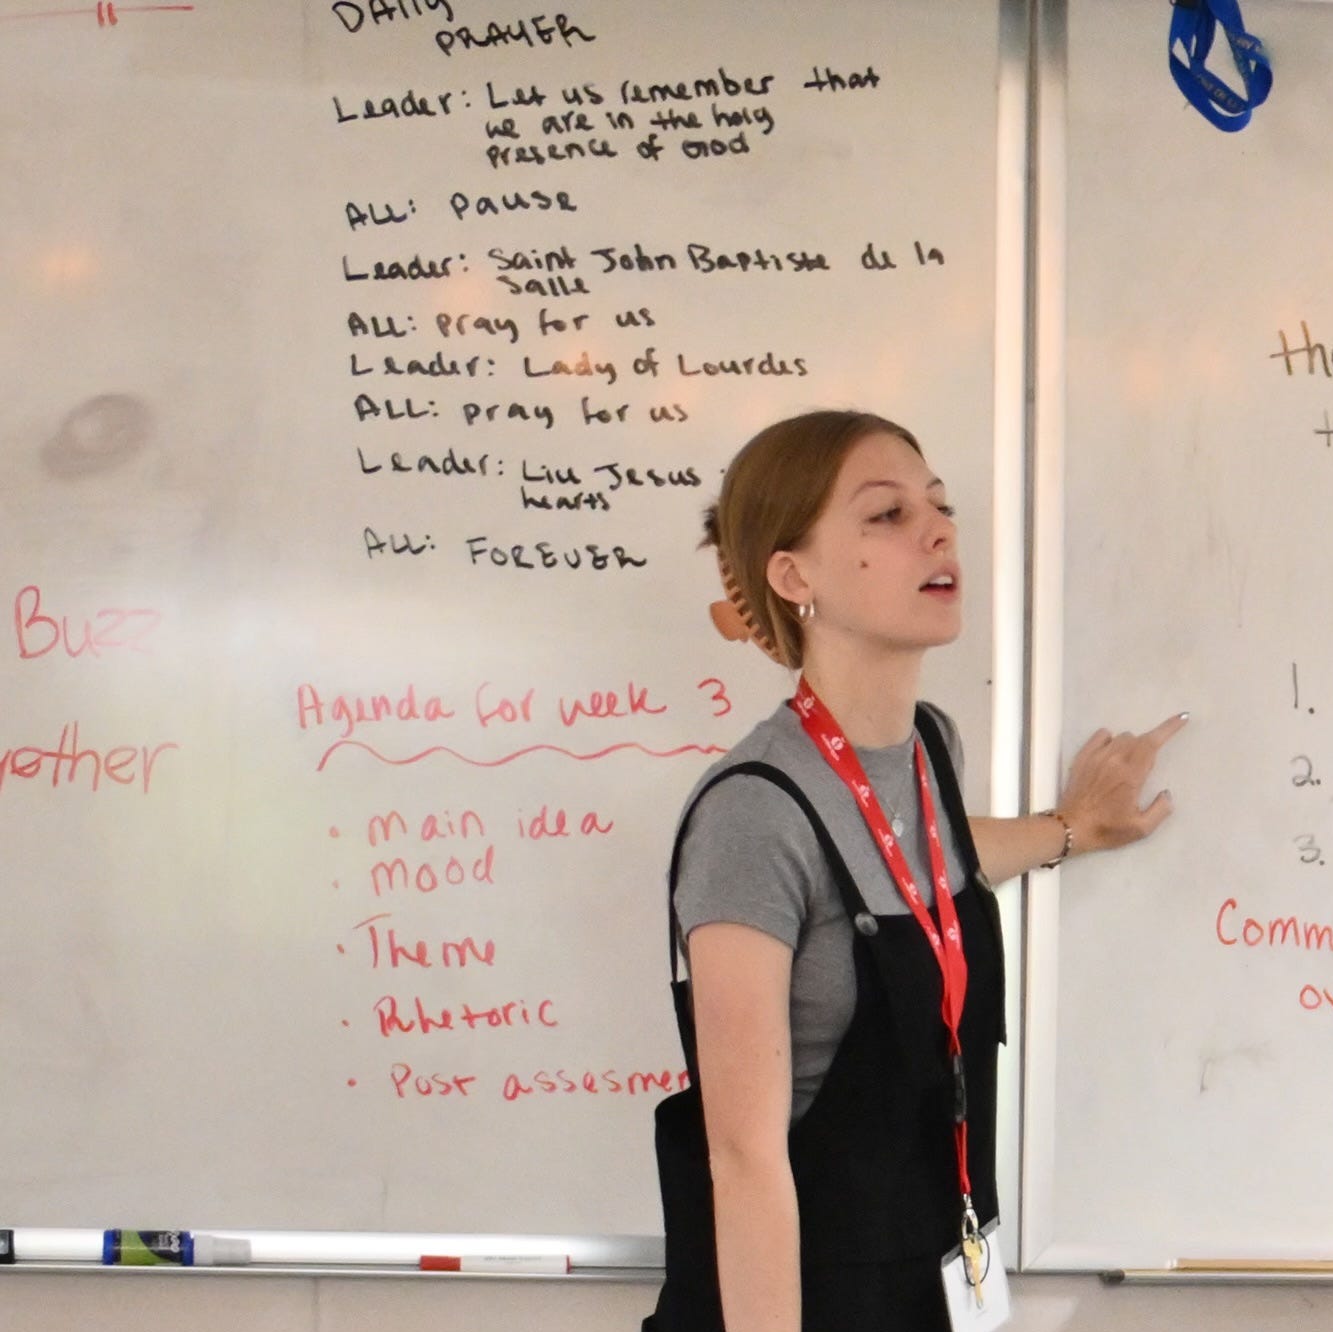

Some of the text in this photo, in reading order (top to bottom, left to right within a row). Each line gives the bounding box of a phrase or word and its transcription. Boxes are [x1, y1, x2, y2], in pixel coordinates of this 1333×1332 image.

[435, 13, 597, 57] PRAYER
[332, 66, 881, 124] Leader: Let us remember that
[541, 110, 595, 136] are
[605, 111, 635, 130] in
[649, 108, 703, 131] the
[636, 132, 665, 162] of
[342, 253, 466, 282] Leader:
[487, 245, 577, 273] Saint
[589, 243, 677, 274] John
[686, 242, 831, 274] Baptiste
[435, 312, 520, 345] pray
[538, 307, 590, 337] for
[615, 307, 656, 328] us
[350, 346, 808, 384] Leader: Lady of Lourdes
[462, 402, 555, 430] pray
[581, 396, 630, 425] for
[648, 404, 689, 423] us
[357, 448, 504, 476] Leader:
[593, 462, 702, 492] Jesus
[520, 485, 611, 512] hearts
[297, 677, 733, 738] Agenda for week 3
[518, 806, 615, 840] idea
[353, 912, 497, 969] Theme
[377, 996, 556, 1037] Rhetoric
[503, 1069, 690, 1102] assesmen
